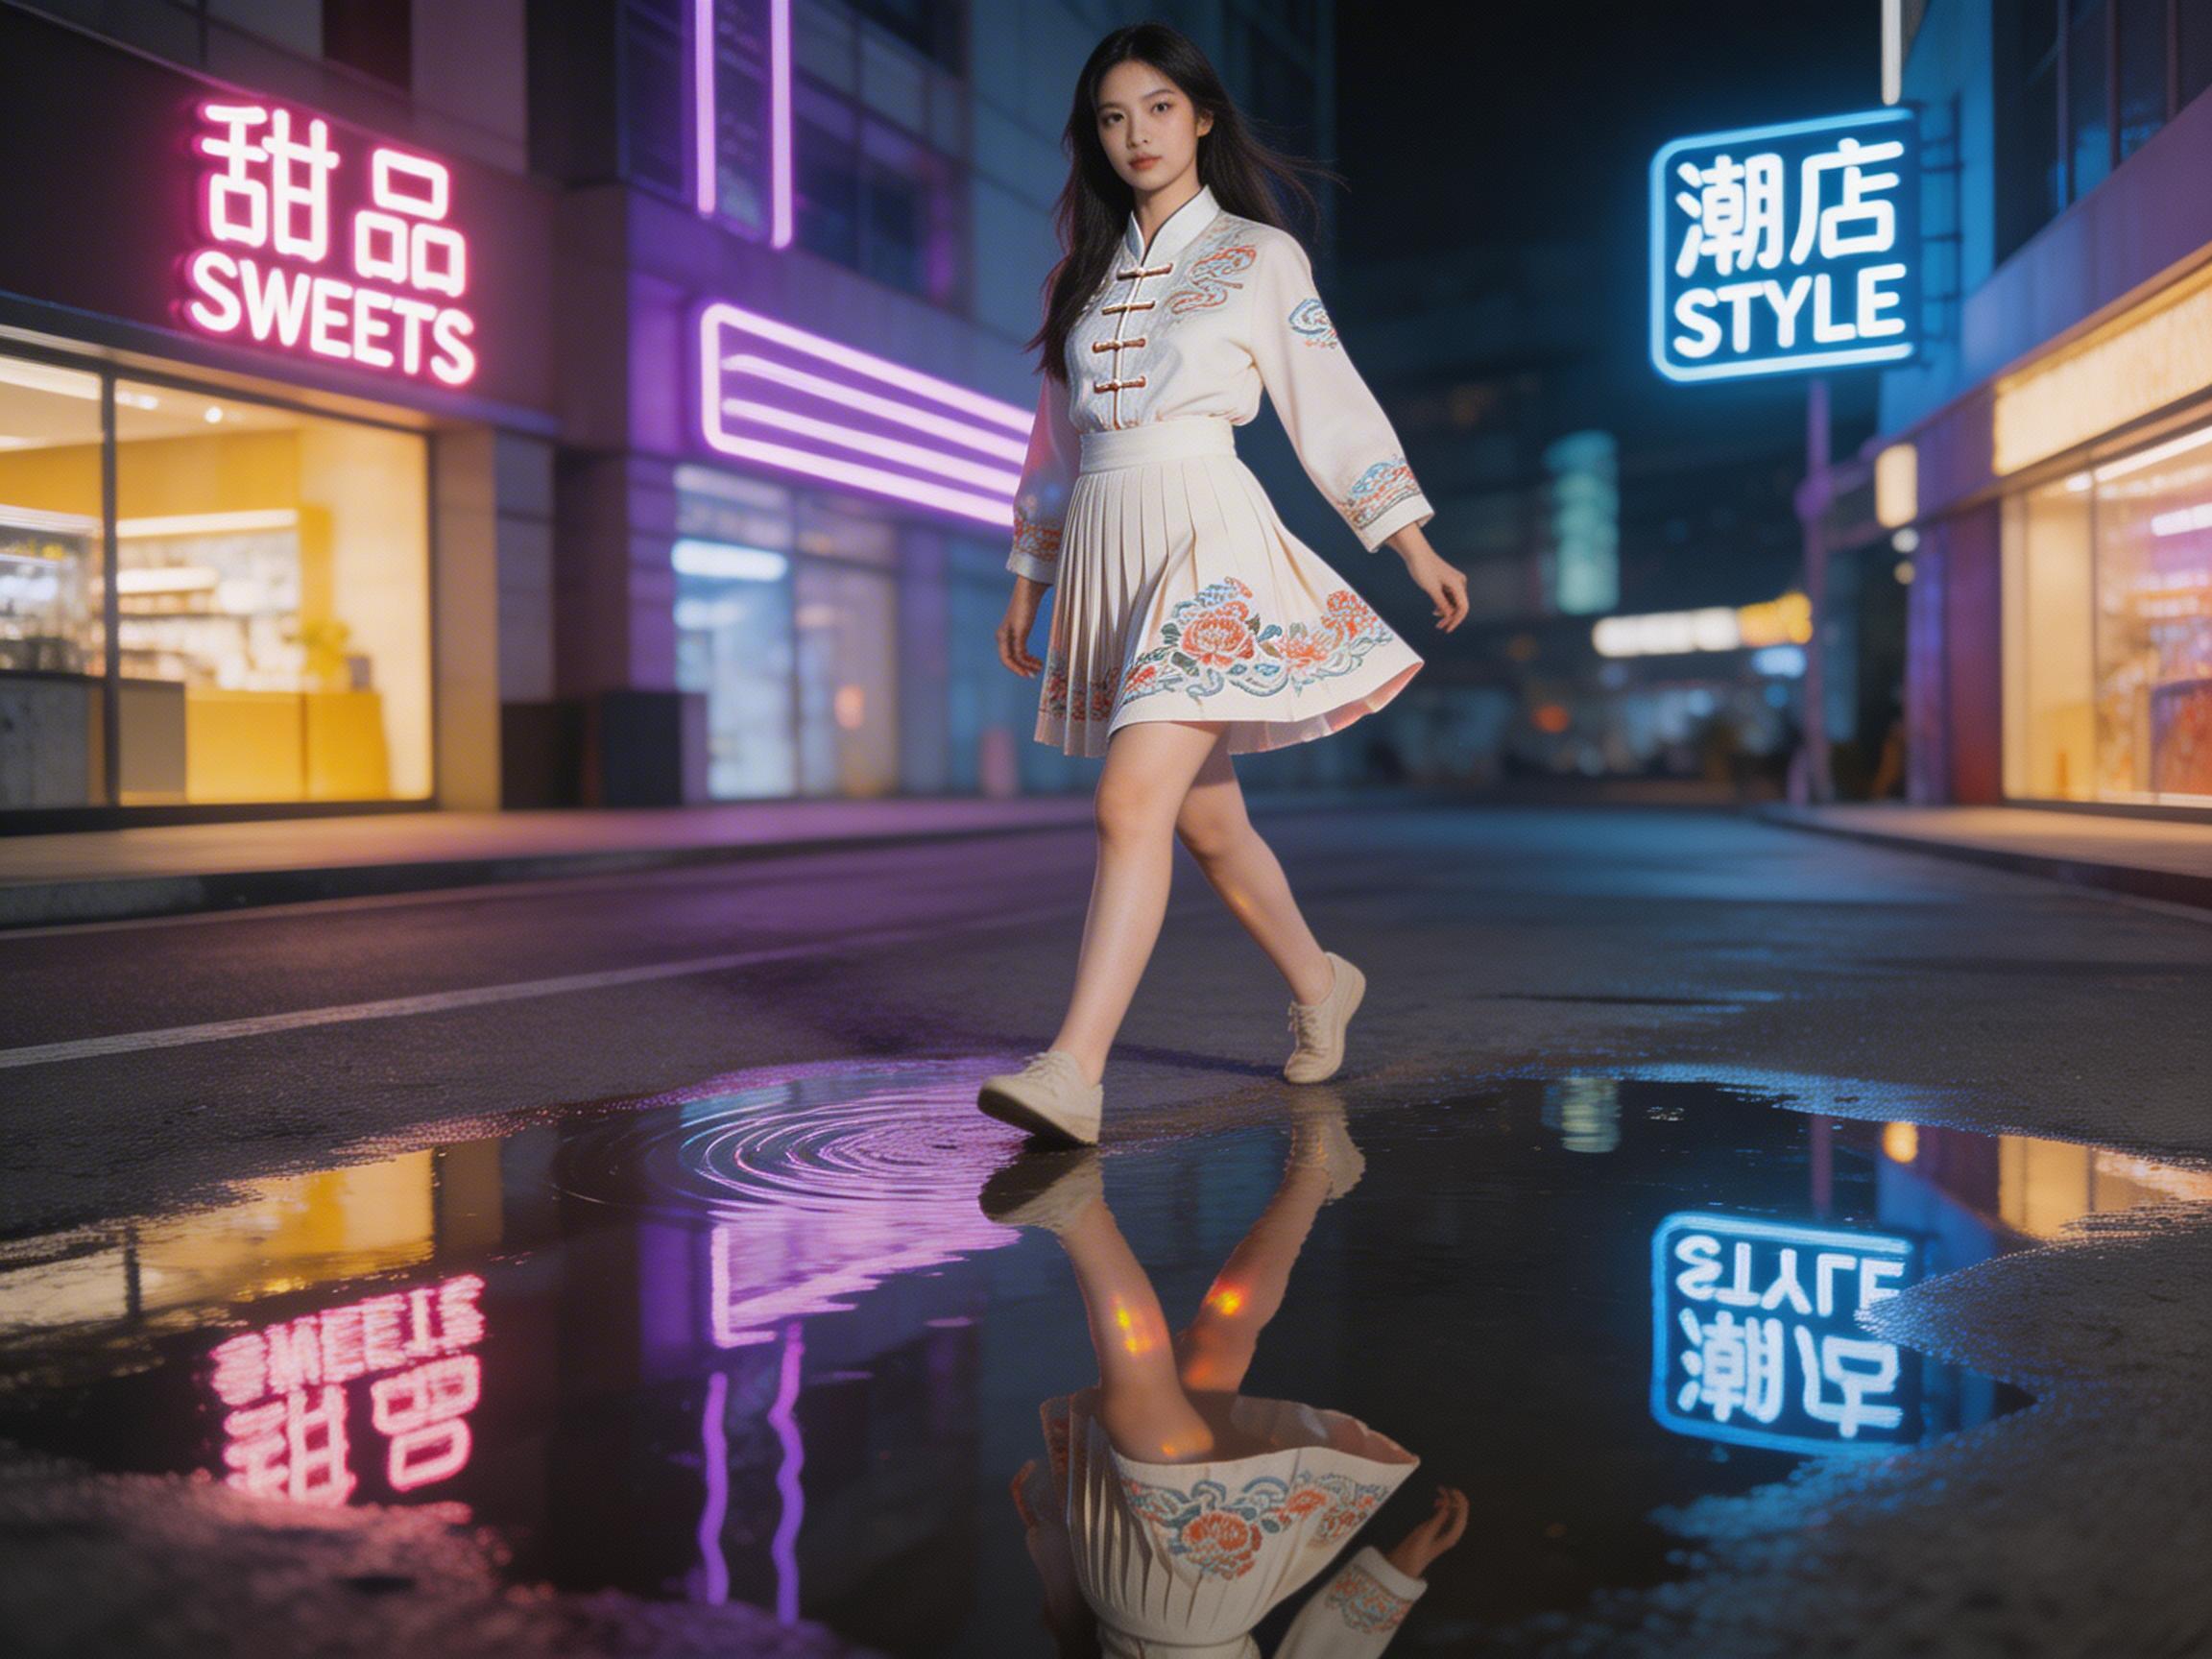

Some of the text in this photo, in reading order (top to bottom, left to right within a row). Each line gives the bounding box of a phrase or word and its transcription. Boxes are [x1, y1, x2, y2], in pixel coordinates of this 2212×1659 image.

[200, 104, 468, 300] 甜品
[1674, 137, 1906, 278] 潮店
[189, 249, 477, 386] SWEETS
[1672, 263, 1908, 359] STYLE
